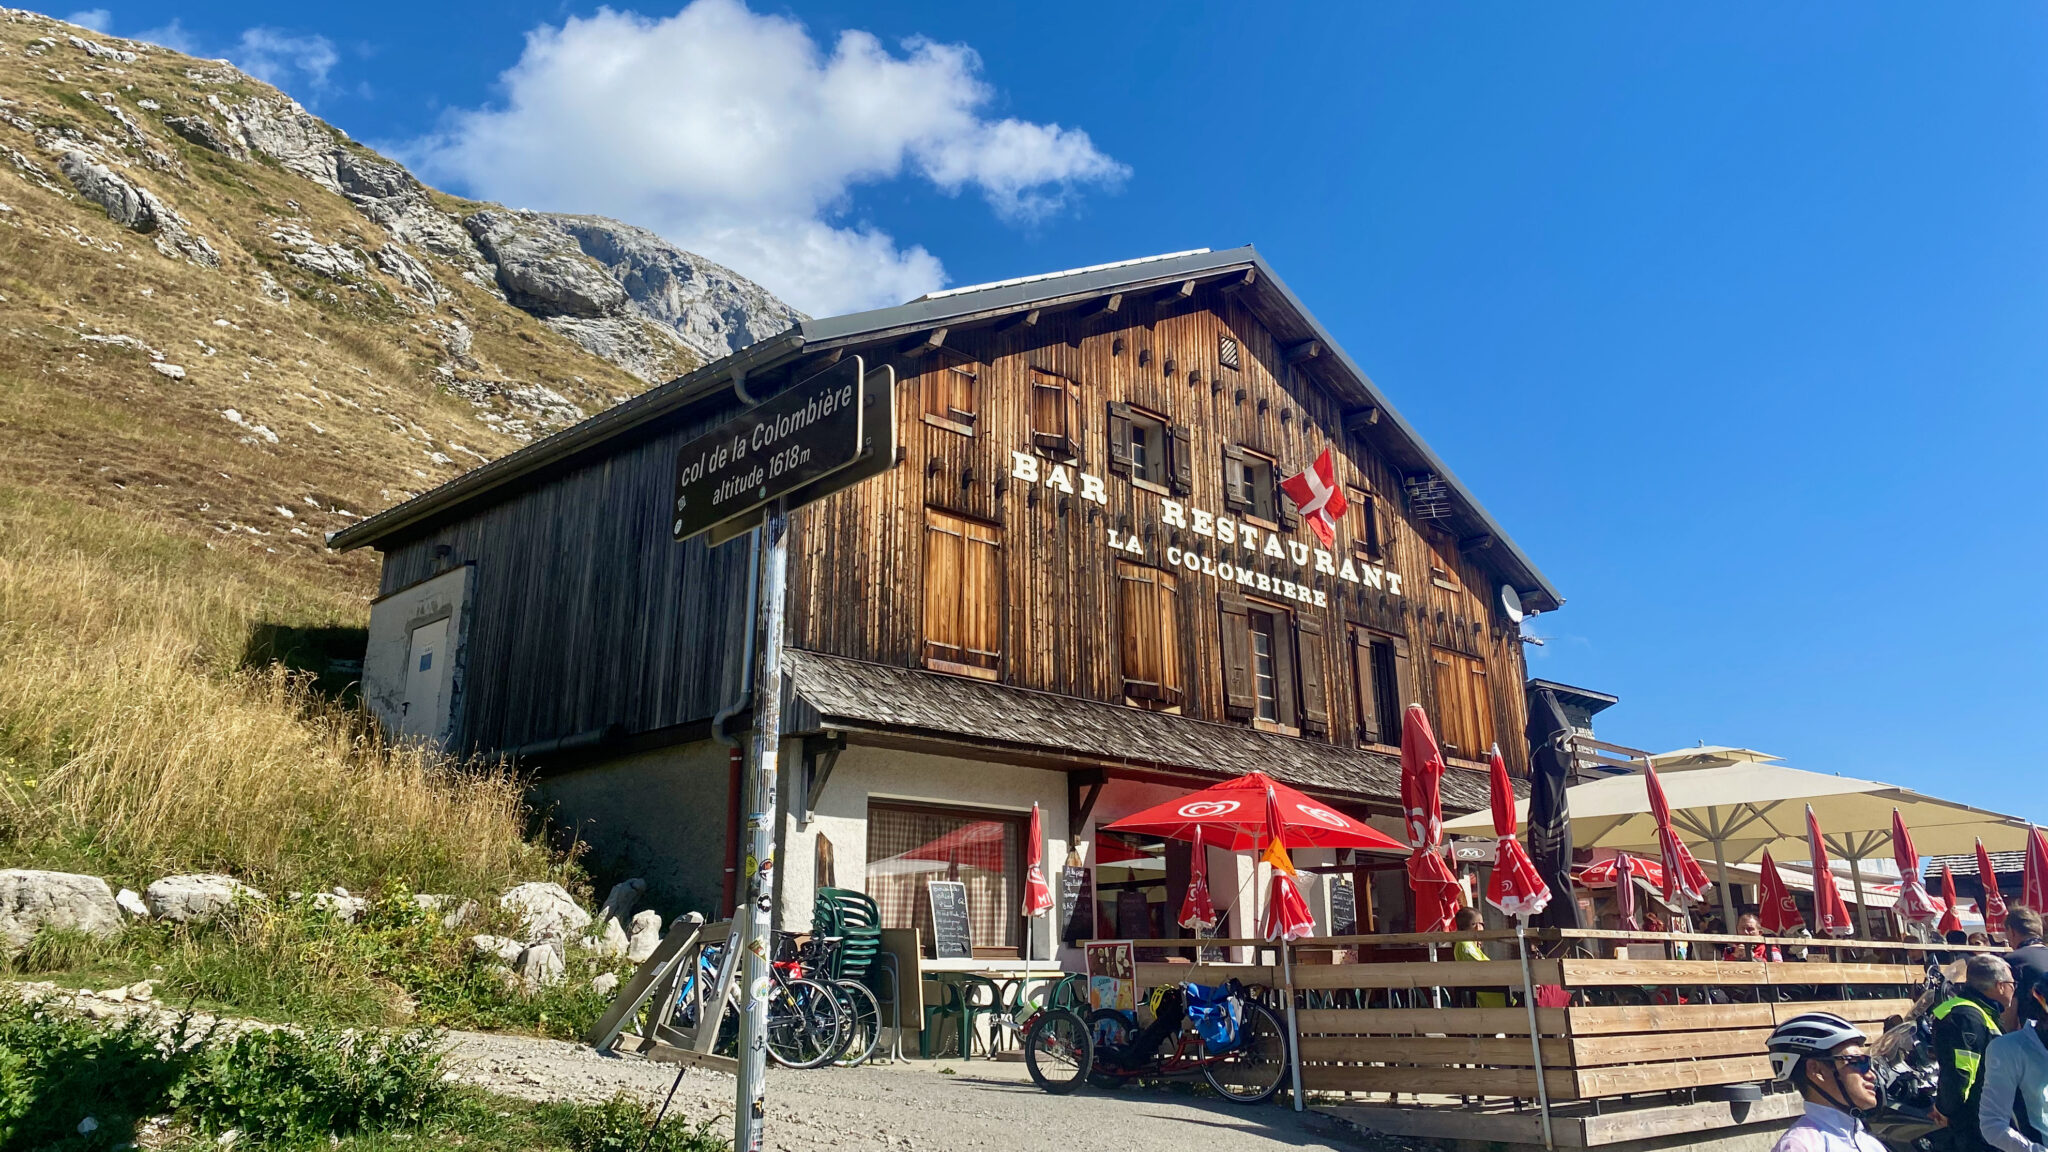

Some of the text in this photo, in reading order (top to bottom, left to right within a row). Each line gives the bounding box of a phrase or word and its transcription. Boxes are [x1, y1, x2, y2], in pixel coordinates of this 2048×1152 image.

[681, 384, 852, 487] col de la Colombière
[712, 465, 763, 505] altitude
[1011, 450, 1108, 505] BAR
[1107, 529, 1328, 609] LA COLOMBIERE
[1161, 498, 1402, 595] RESTAURANT
